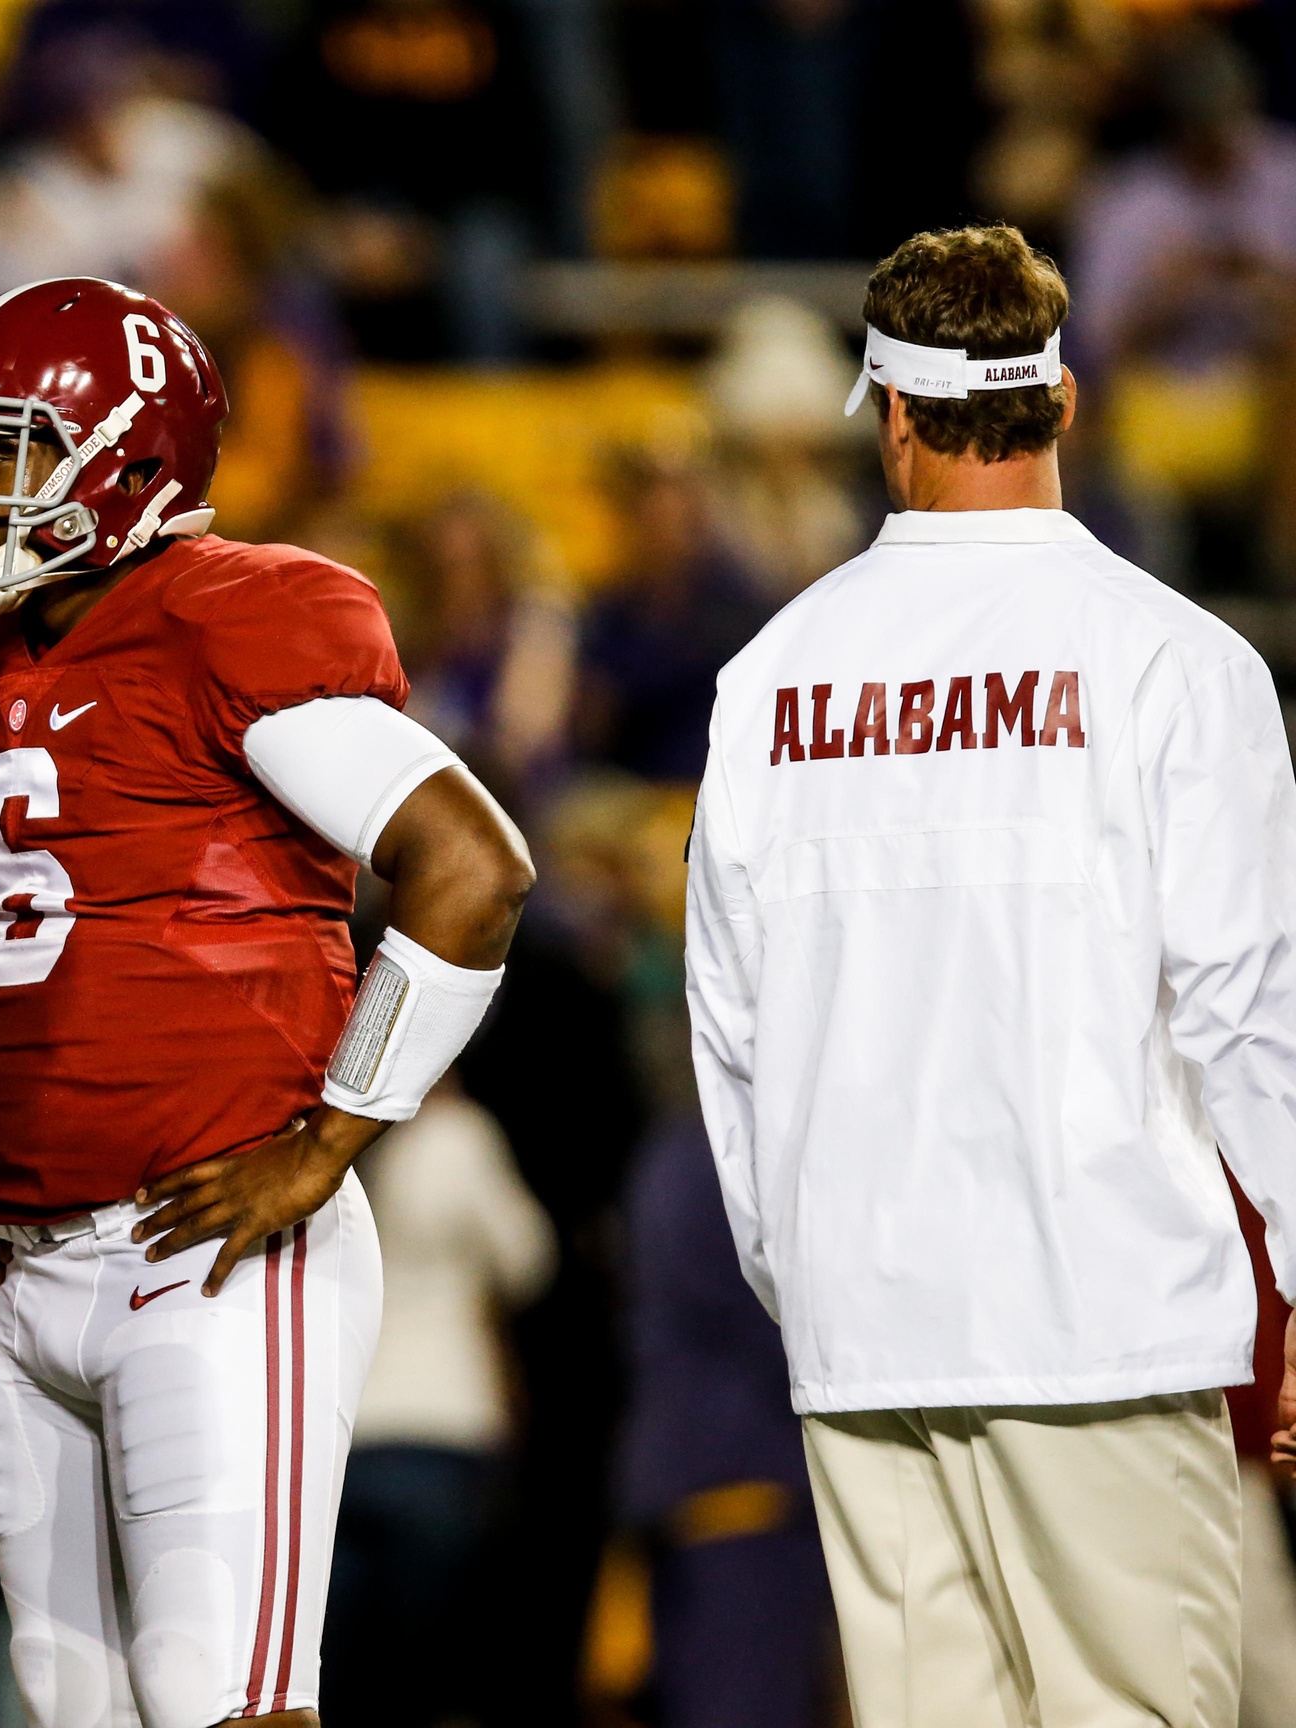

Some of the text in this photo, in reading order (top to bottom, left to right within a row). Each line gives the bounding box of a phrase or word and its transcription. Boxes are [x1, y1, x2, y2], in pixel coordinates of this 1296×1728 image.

[121, 313, 167, 393] 6
[914, 377, 952, 389] DRI-FIT
[984, 364, 1038, 383] ALABAMA
[37, 459, 74, 499] RIMSON
[769, 670, 1086, 767] ALABAMA
